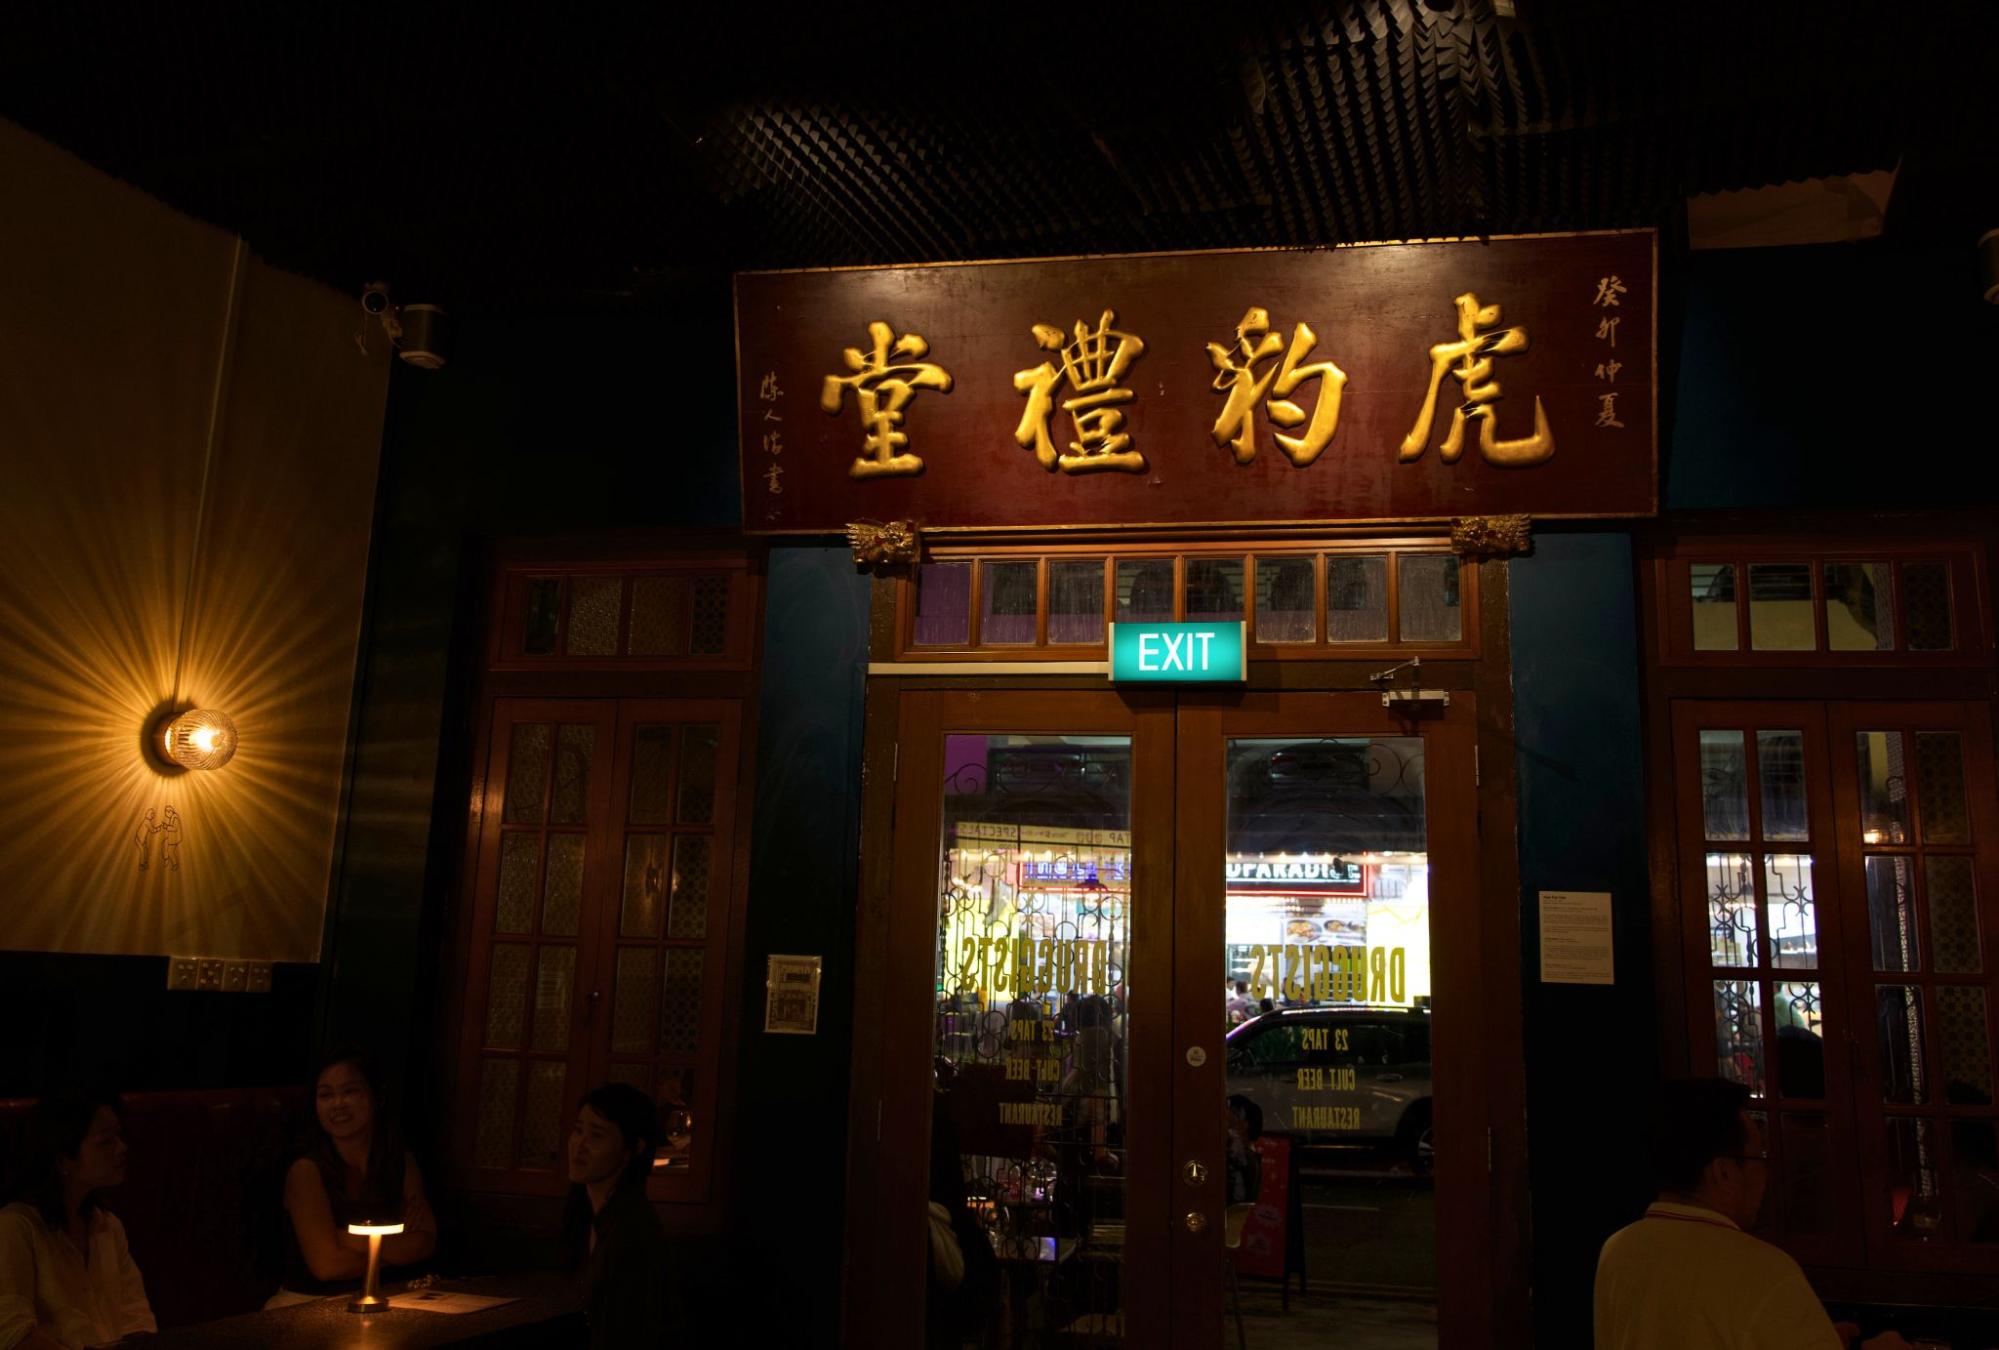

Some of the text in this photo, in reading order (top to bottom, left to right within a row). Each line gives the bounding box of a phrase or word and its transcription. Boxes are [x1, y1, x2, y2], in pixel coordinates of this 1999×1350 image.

[1593, 275, 1627, 429] 癸卯仲夏
[1139, 632, 1215, 671] EXIT
